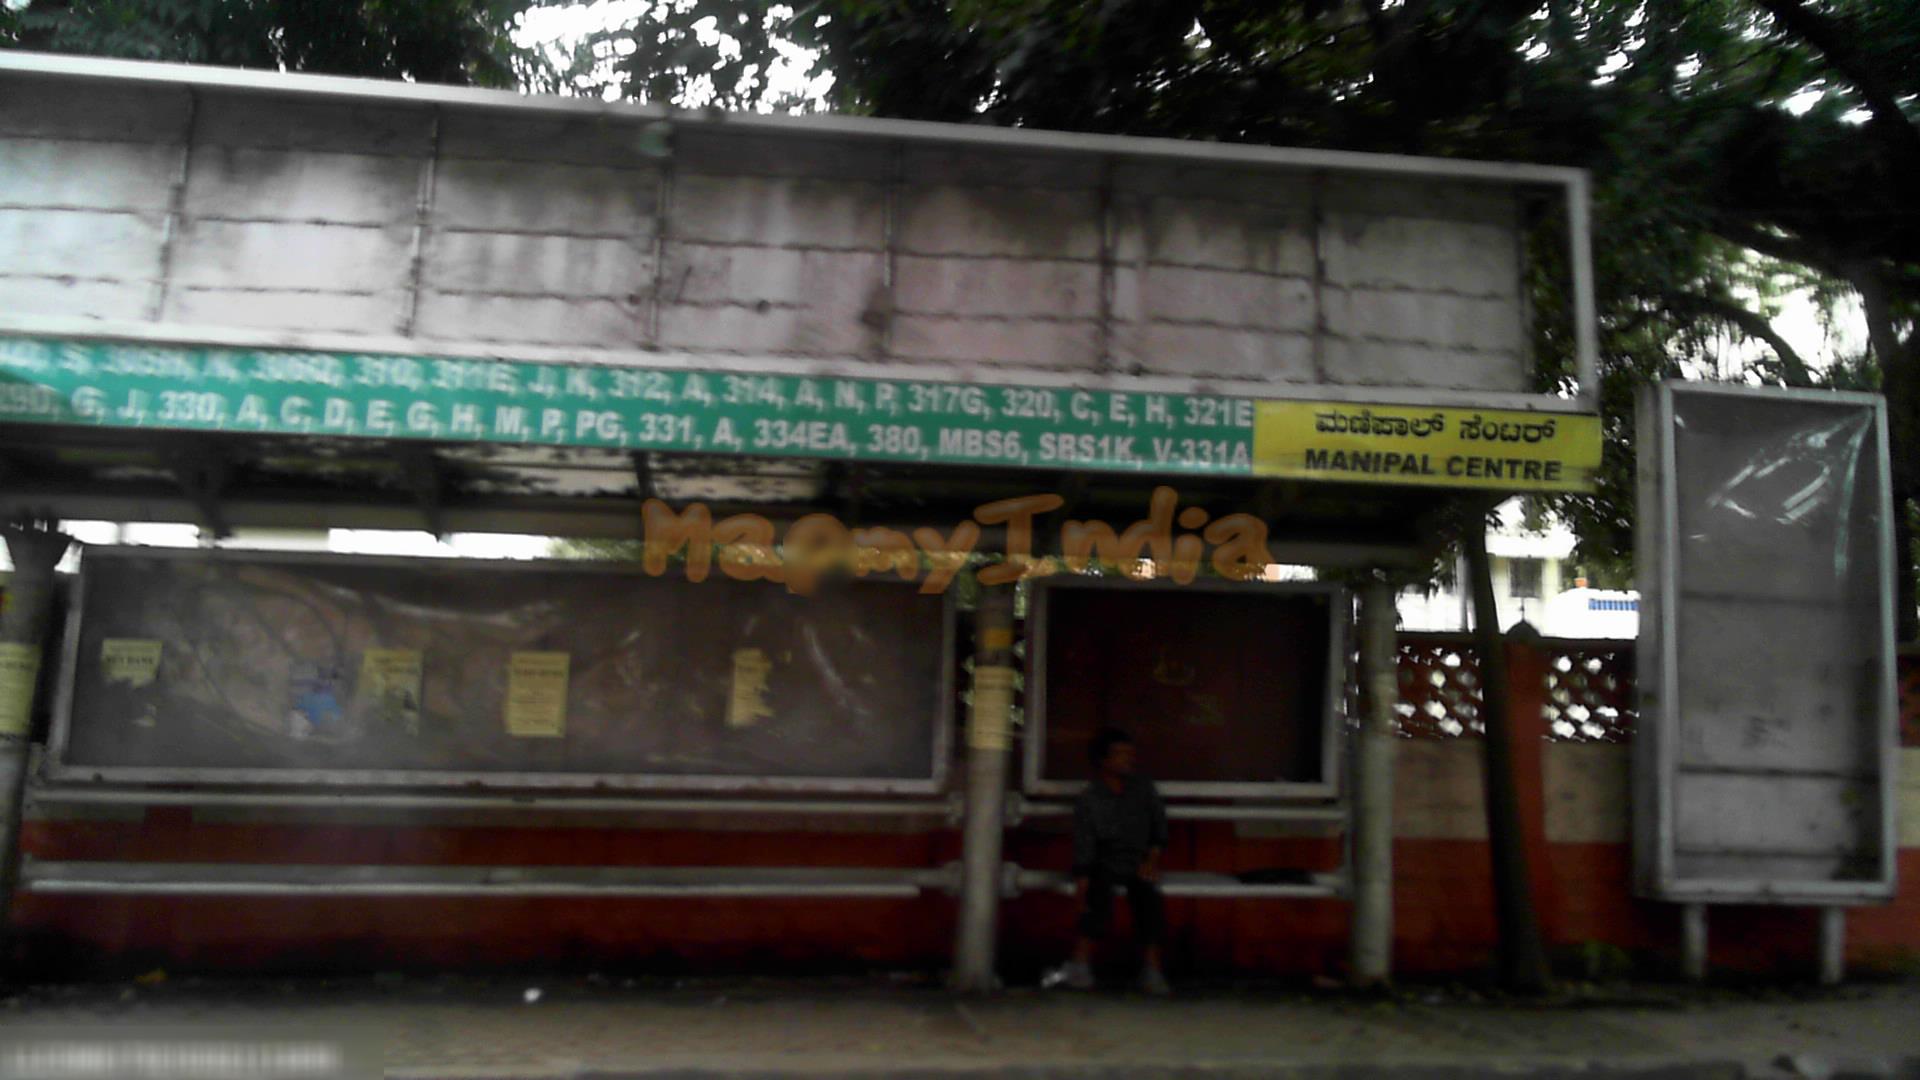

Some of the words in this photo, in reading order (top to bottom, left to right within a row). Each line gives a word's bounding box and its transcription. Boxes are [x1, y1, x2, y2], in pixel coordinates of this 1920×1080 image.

[566, 368, 598, 401] K,
[608, 369, 673, 404] 312,
[682, 373, 714, 408] A,
[722, 375, 786, 411] 314,
[794, 380, 825, 413] A,
[834, 381, 866, 414] N,
[875, 383, 899, 417] P,
[907, 384, 994, 421] 317G,
[1000, 388, 1063, 423] 320,
[1070, 391, 1101, 426] C,
[1109, 393, 1138, 428] E,
[1145, 395, 1175, 430] H,
[1184, 397, 1254, 427] 321E
[71, 386, 106, 425] G,
[115, 389, 148, 426] J,
[156, 391, 226, 429] 330,
[235, 394, 268, 431] A,
[280, 396, 312, 433] C,
[323, 398, 355, 436] D,
[366, 400, 394, 438] E,
[406, 401, 440, 439] G,
[452, 404, 483, 440] H,
[495, 405, 529, 443] M,
[541, 408, 564, 444] P,
[576, 410, 627, 447] PG,
[639, 413, 702, 450] 331,
[712, 416, 742, 453] A,
[754, 418, 856, 457] 334EA,
[868, 424, 928, 461] 380,
[938, 428, 1028, 466] MBS6,
[1039, 432, 1143, 471] SBS1K,
[1152, 437, 1249, 468] V-331A
[1314, 408, 1444, 438] ಮಣಿಪಾಲ್
[1459, 414, 1555, 444] ಸೆಂಟರ್
[1305, 449, 1436, 476] MANIPAL
[1446, 456, 1562, 482] CENTRE
